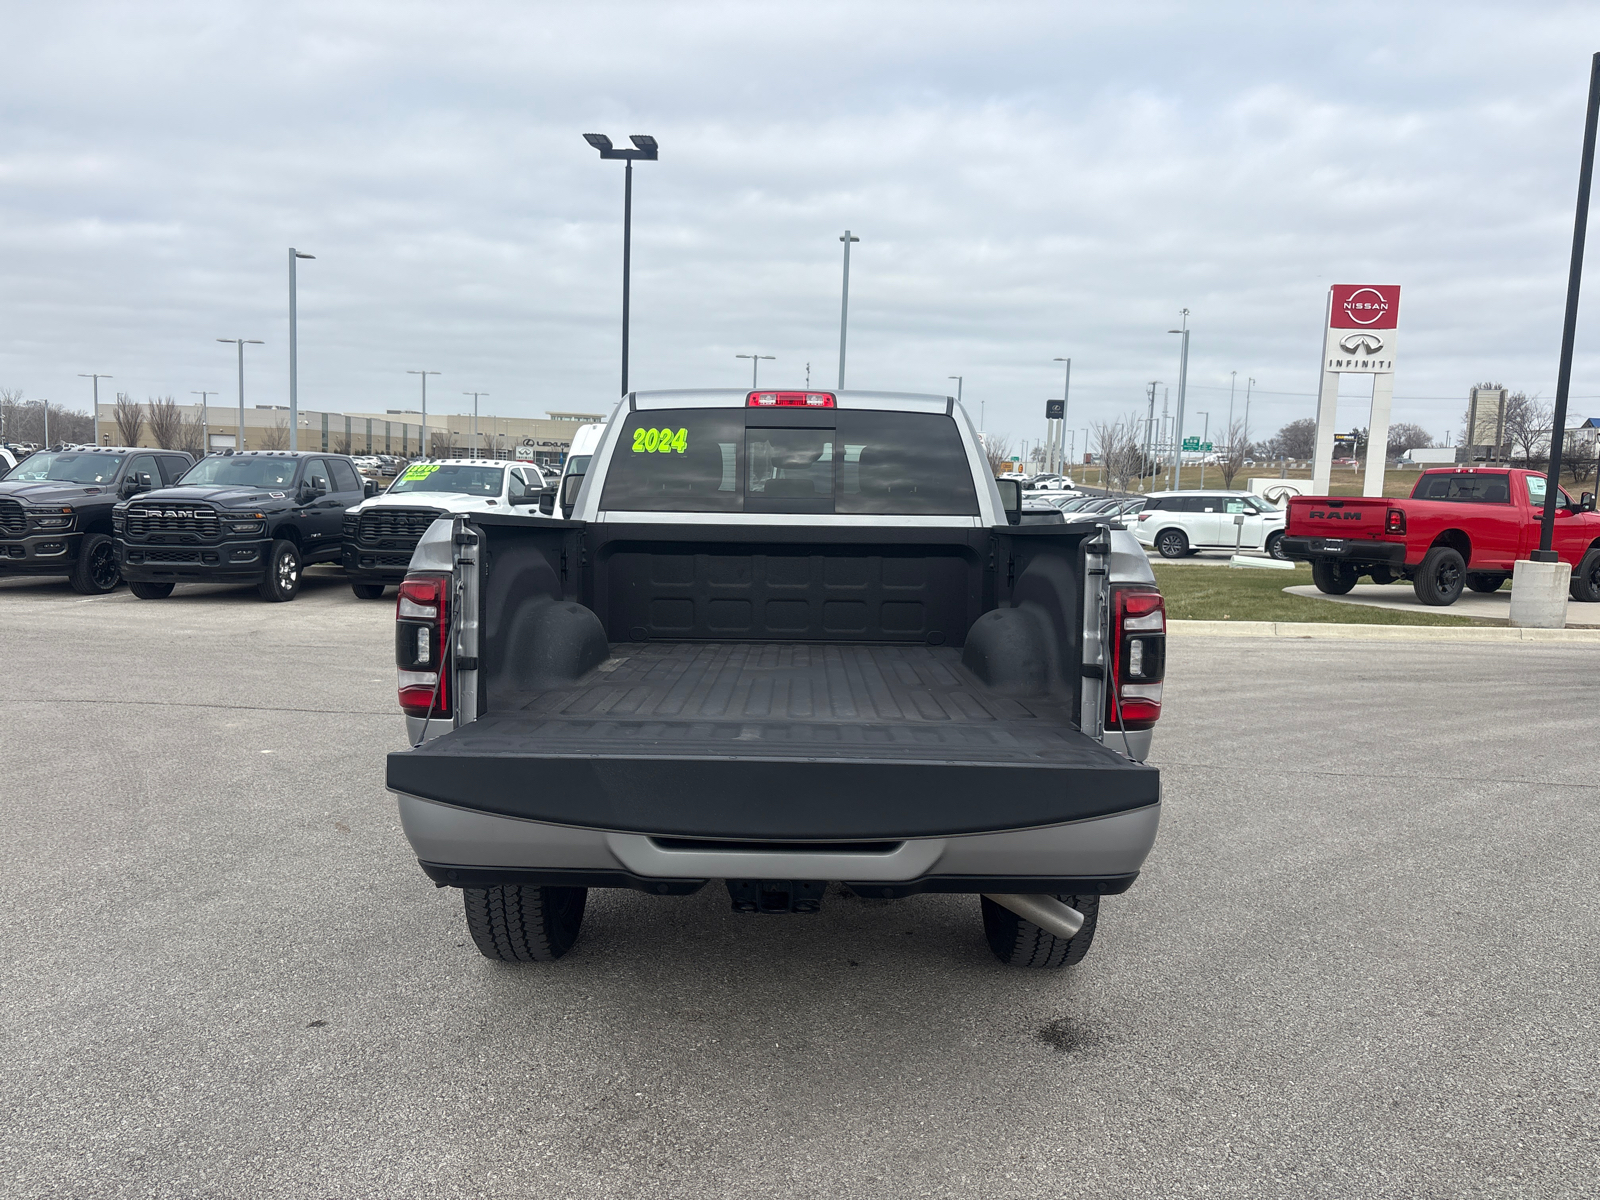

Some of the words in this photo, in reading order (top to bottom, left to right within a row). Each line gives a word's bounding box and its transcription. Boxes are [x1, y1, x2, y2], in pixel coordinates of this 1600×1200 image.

[1343, 302, 1389, 310] NISSAN
[1329, 359, 1392, 369] INFINITI
[632, 427, 688, 454] 2024
[148, 510, 193, 518] RAM
[1309, 510, 1362, 521] RAM
[380, 516, 424, 525] RAM
